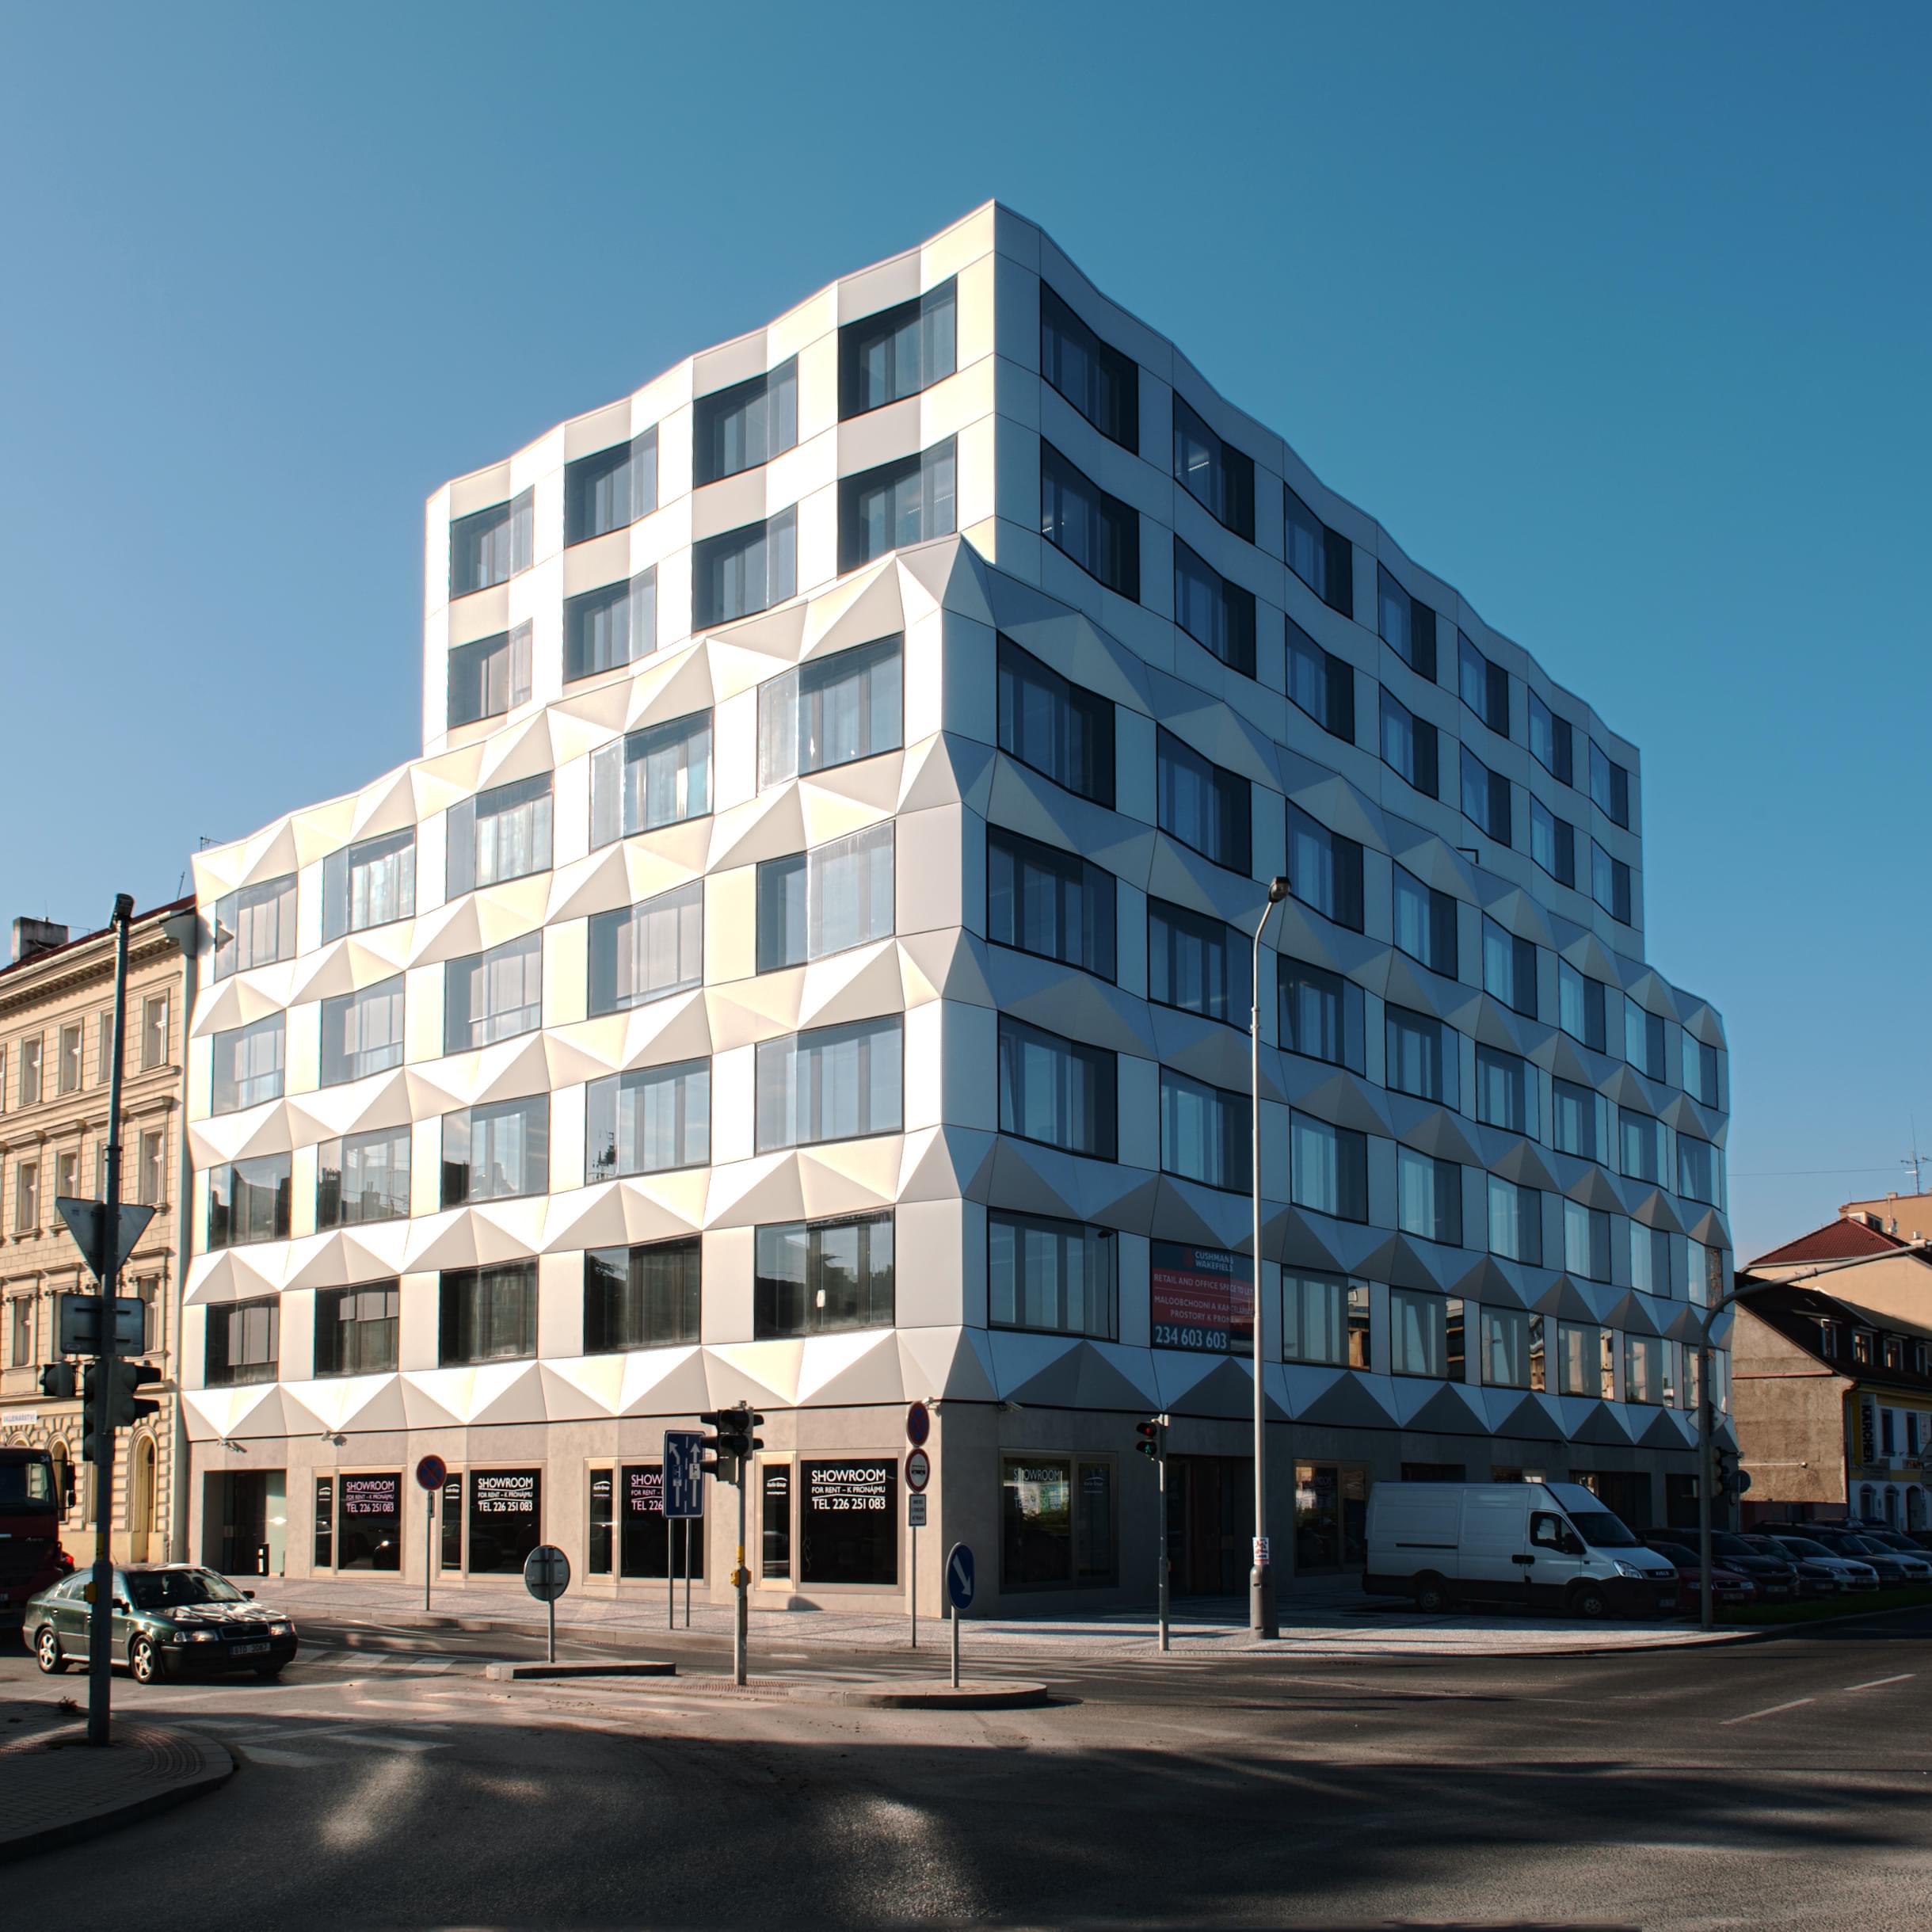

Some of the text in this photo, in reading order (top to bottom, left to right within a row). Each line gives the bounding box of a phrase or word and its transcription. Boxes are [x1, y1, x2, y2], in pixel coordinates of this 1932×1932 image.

[1195, 1251, 1230, 1263] CUSHMAN
[1195, 1259, 1233, 1272] WAKEFIELD
[1153, 1273, 1177, 1284] RETAIL
[1179, 1277, 1193, 1287] AND
[1195, 1280, 1218, 1290] OFFICE
[1170, 1309, 1206, 1320] PROSTORY
[1155, 1325, 1227, 1350] 234 603 603
[631, 1473, 663, 1485] SHOW
[812, 1469, 886, 1482] SHOWROOM
[1014, 1468, 1061, 1481] SOWROOM
[346, 1480, 394, 1491] SHOWROOM
[478, 1477, 533, 1488] SHOWROOM
[852, 1485, 886, 1495] PRONÁJMU
[346, 1503, 394, 1513] TEL 226 251 083
[478, 1501, 533, 1511] TEL 226 251 083
[631, 1500, 662, 1511] TEL 226
[812, 1498, 886, 1510] TEL 226 251 083
